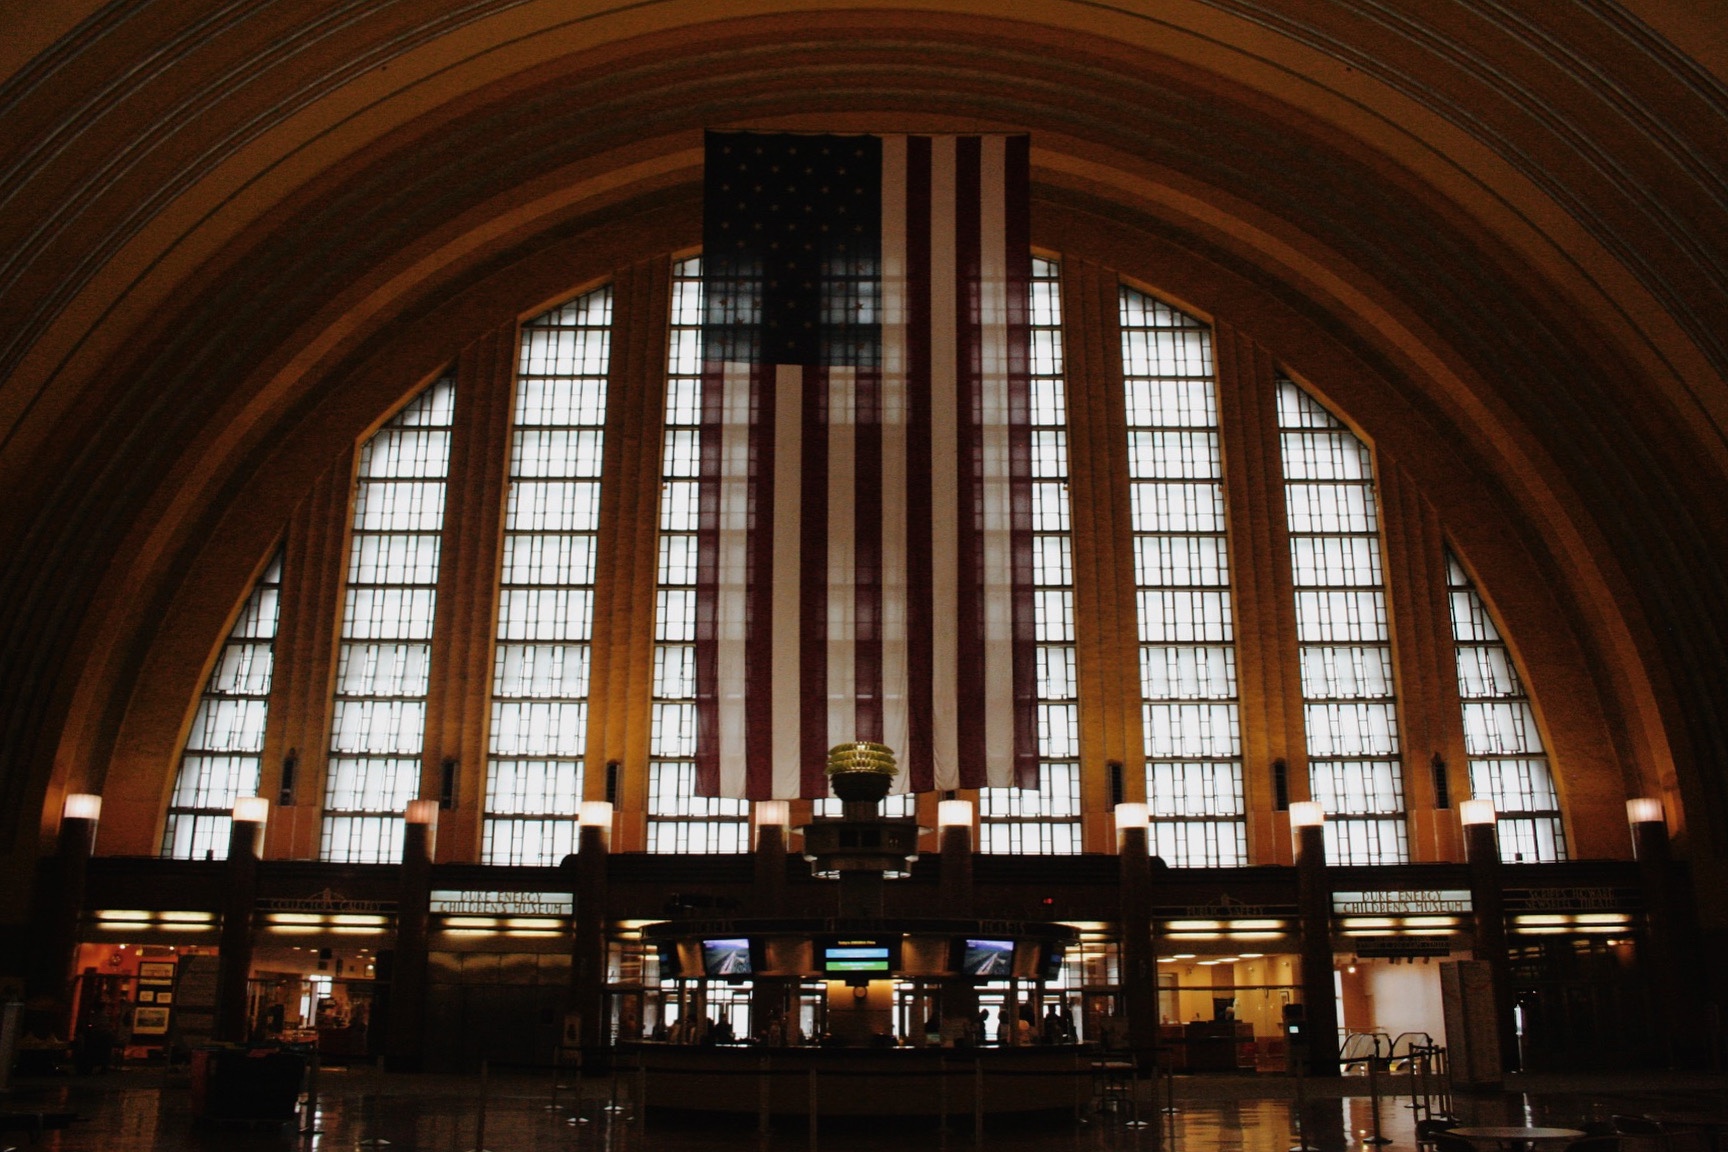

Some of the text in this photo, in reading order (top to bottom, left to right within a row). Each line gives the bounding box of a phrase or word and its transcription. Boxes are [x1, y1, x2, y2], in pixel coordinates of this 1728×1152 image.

[461, 891, 542, 903] DUKE ENERGY
[1362, 890, 1442, 901] DUKE ENERGY
[440, 901, 563, 914] CHILDREN'S MUSEUM
[1343, 901, 1463, 913] CHILDREN'S MUSEUM
